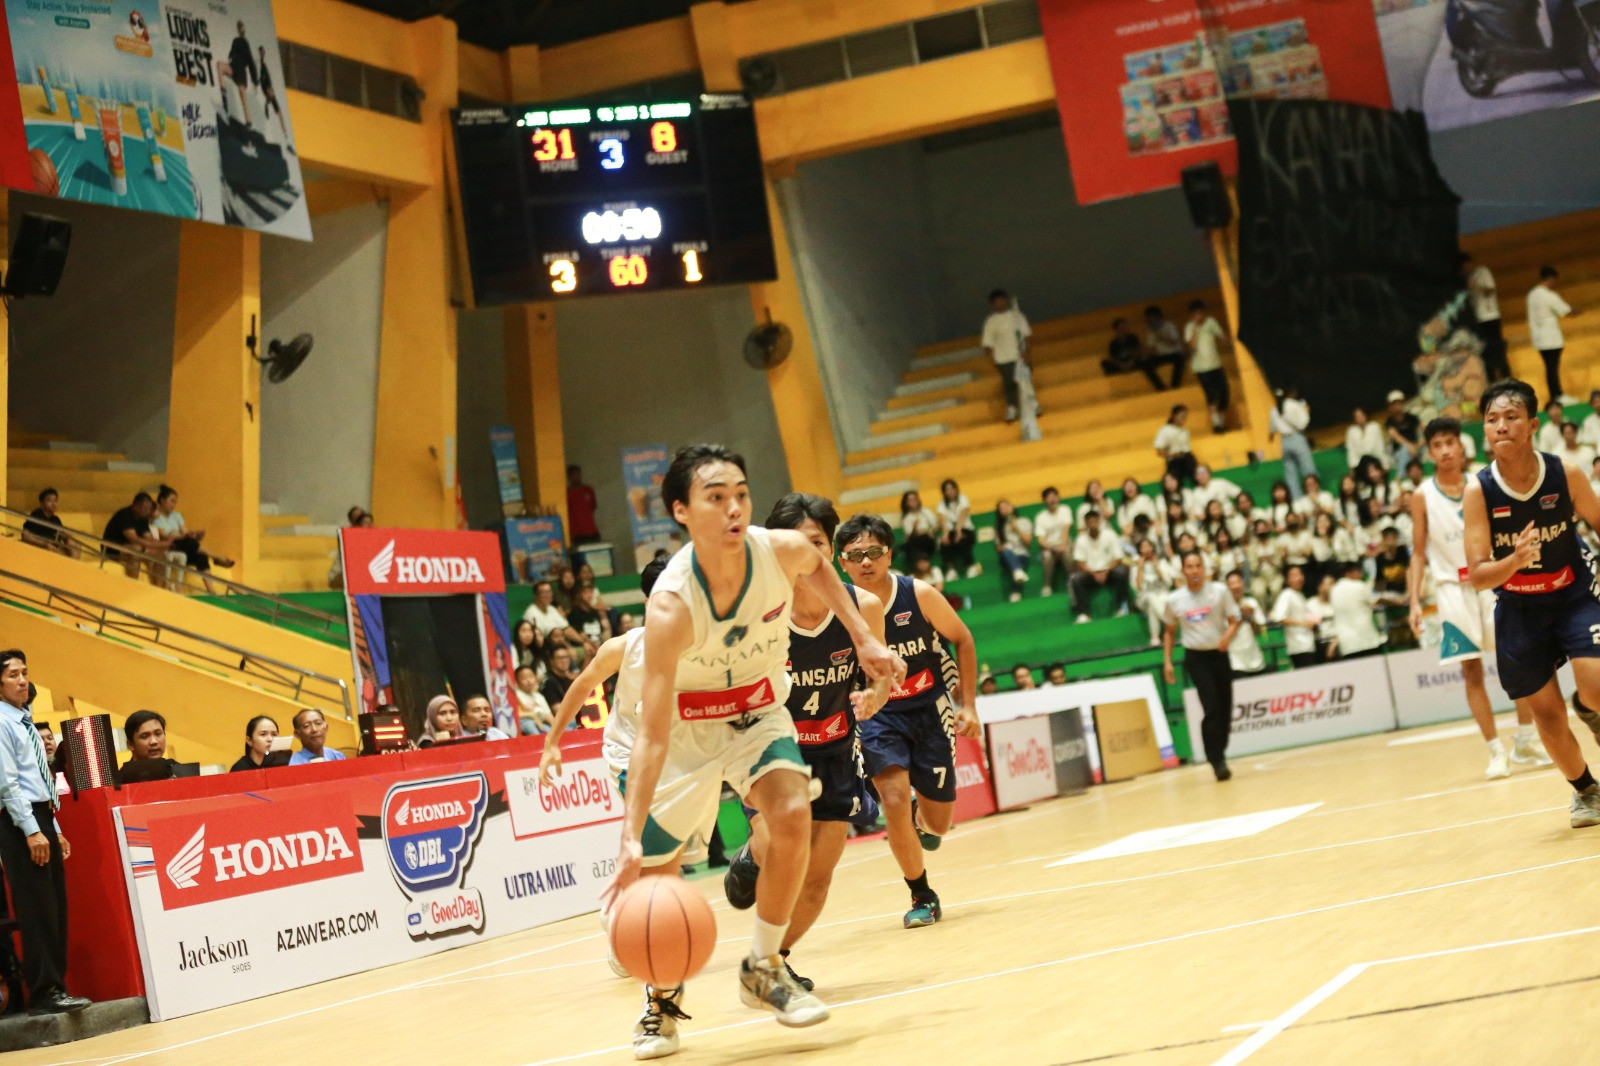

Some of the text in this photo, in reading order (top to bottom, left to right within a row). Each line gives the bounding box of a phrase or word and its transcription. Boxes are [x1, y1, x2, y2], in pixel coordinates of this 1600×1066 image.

[166, 12, 210, 49] LOOKS
[173, 47, 215, 87] BEST
[532, 128, 576, 161] 31
[650, 121, 677, 153] 8
[598, 138, 625, 170] 3
[549, 259, 577, 293] 3
[608, 254, 648, 287] 60
[682, 249, 703, 282] 1
[1495, 521, 1567, 547] MAARA
[395, 557, 485, 583] HONDA
[888, 637, 926, 658] SARA
[790, 661, 855, 687] ANSARA
[684, 707, 704, 718] One
[802, 691, 820, 716] 4
[1291, 705, 1351, 723] NETWORK
[75, 716, 103, 788] 1
[798, 733, 822, 742] EART.
[933, 766, 947, 789] 7
[411, 800, 466, 824] HONDA
[210, 825, 355, 883] HONDA
[418, 837, 446, 870] DBL
[504, 862, 577, 900] ULTRA MILK
[276, 909, 379, 953] AZAWEAR.COM
[178, 935, 250, 972] Jackson
[232, 961, 251, 974] SHOES
